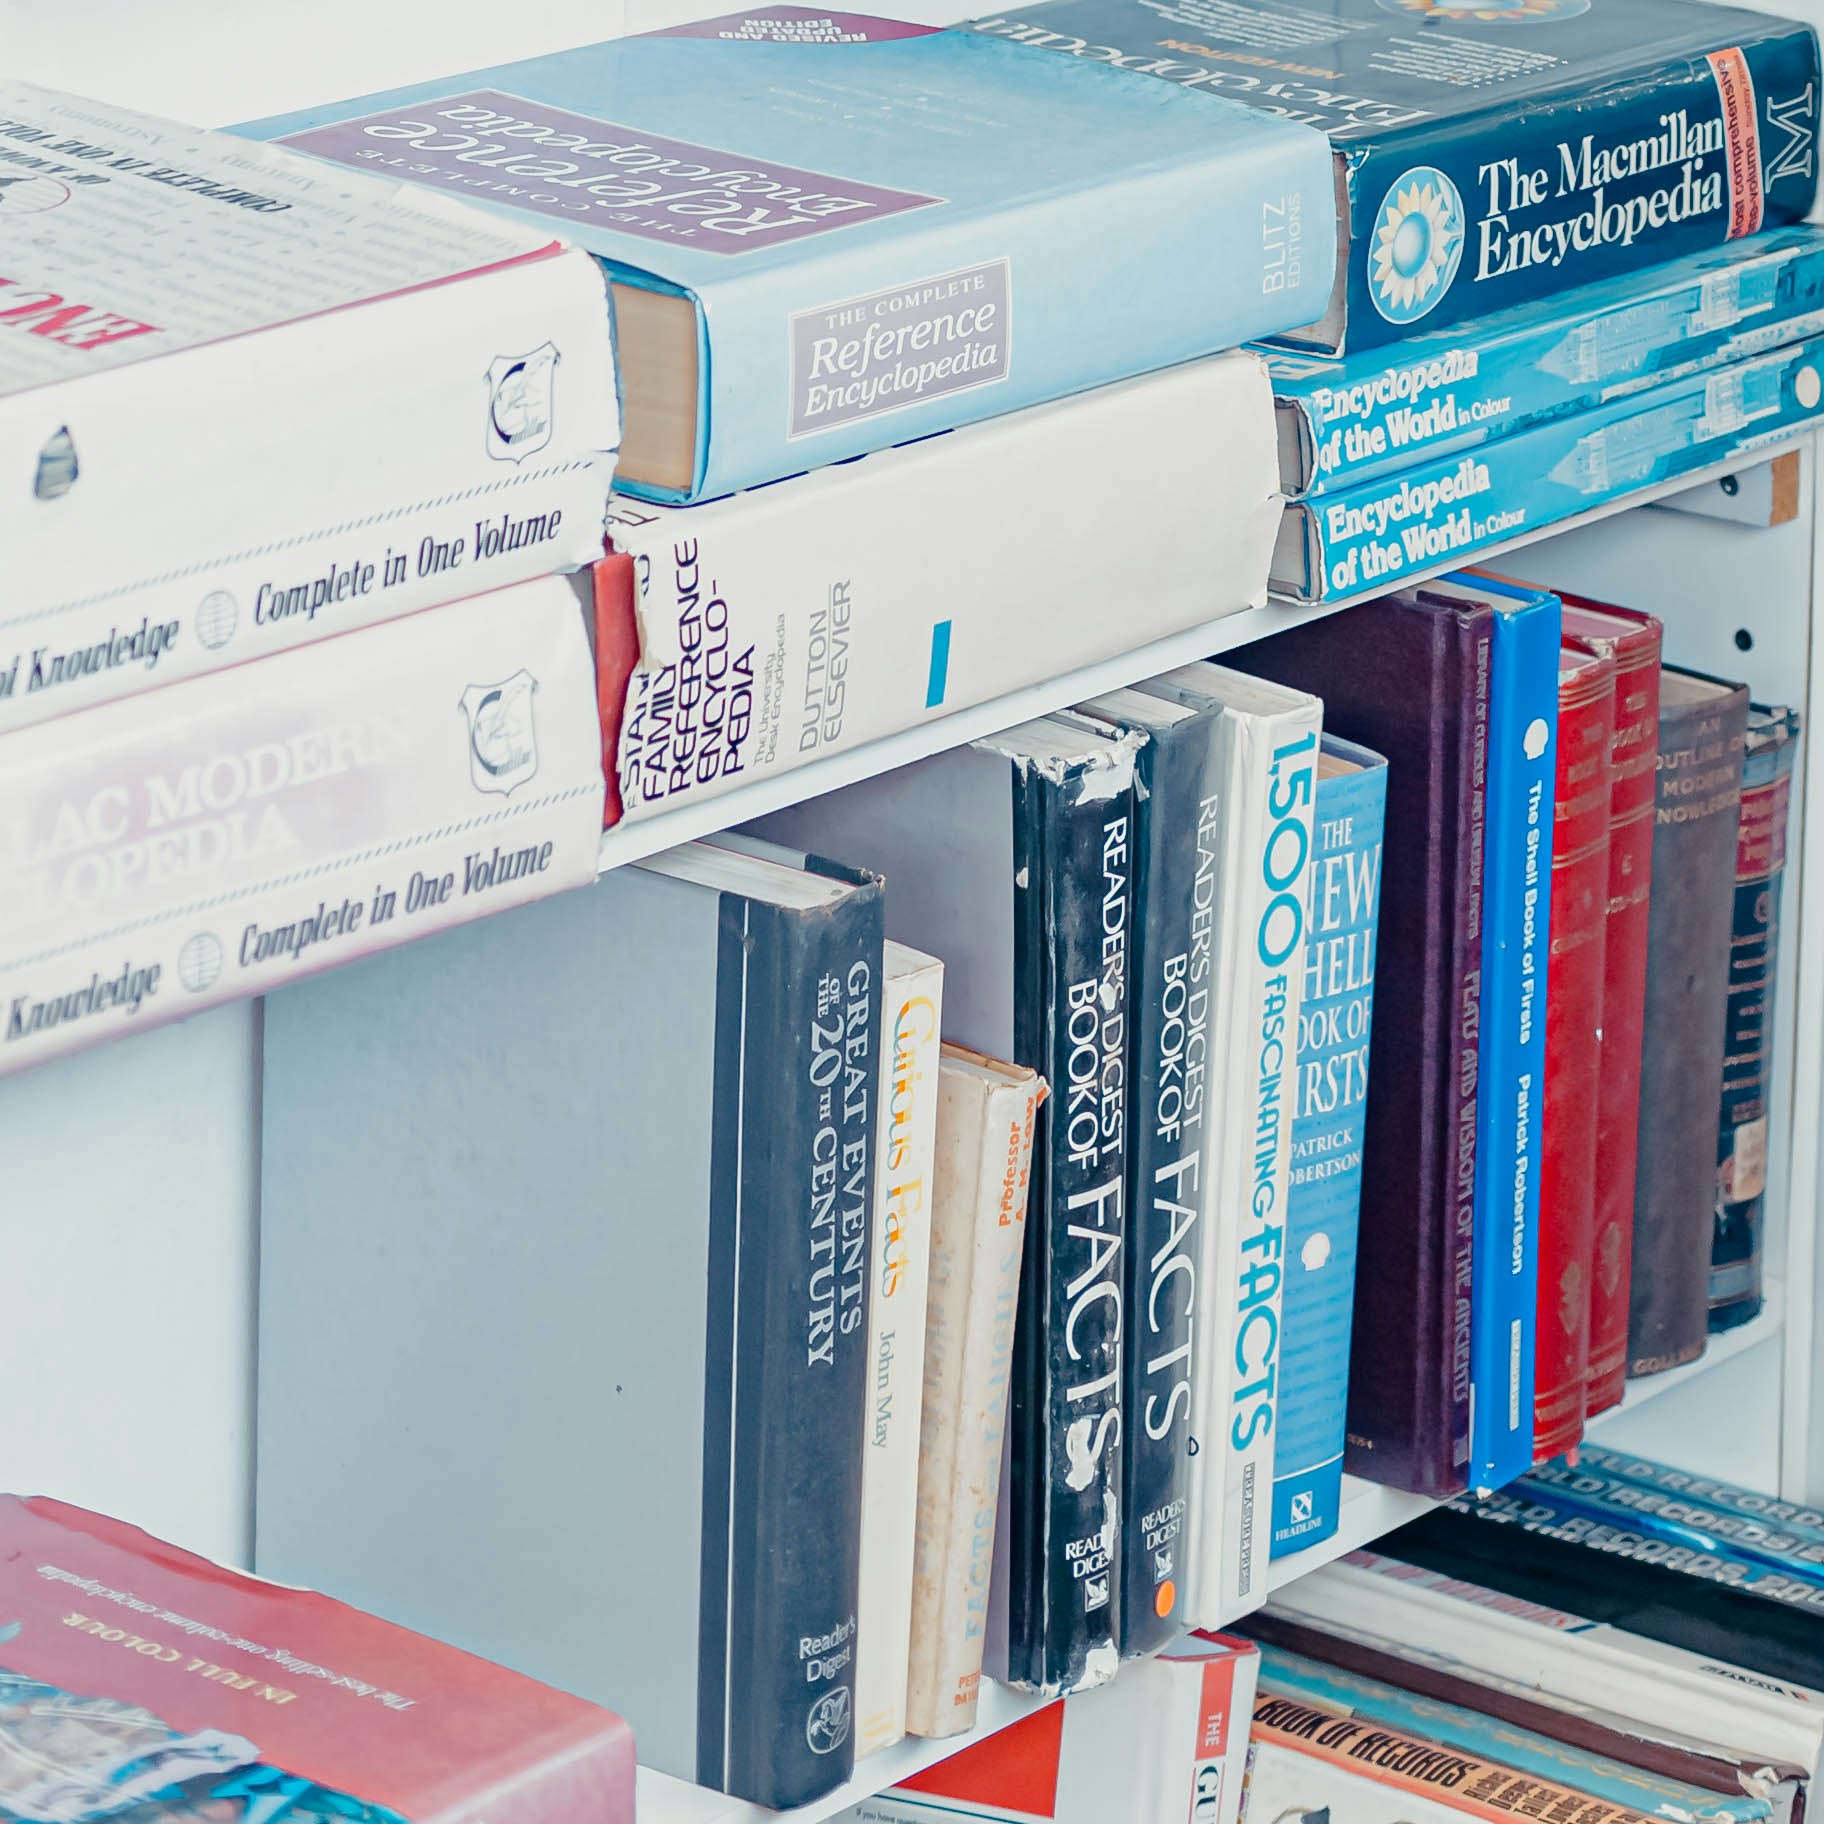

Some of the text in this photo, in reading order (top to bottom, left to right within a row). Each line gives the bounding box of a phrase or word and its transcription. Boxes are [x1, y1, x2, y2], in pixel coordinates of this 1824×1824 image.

[363, 120, 818, 238] Reference
[436, 102, 877, 217] Encyclopedia
[1477, 108, 1726, 219] The Macmillan
[1261, 195, 1288, 295] BLITZ
[1287, 191, 1302, 290] EDITIONS
[1473, 164, 1724, 282] Encyclopedia
[808, 302, 997, 380] Reference
[824, 274, 985, 329] THE COMPLETE
[803, 342, 998, 417] Encyclopedia
[1316, 348, 1480, 422] Encyclopedia
[1319, 391, 1513, 473] of the World in Colour
[1327, 460, 1491, 545] Encyclopedia
[1330, 505, 1526, 590] of the World in Colour
[27, 507, 563, 694] Knowledge Complete in One Volume
[667, 536, 699, 796] REFERENCE
[720, 643, 755, 777] PEDIA
[798, 609, 828, 752] DUTTON
[823, 578, 851, 743] ELSEVIER
[1321, 816, 1353, 852] THE
[238, 839, 554, 968] Complete in One Volume
[818, 972, 830, 1019] THE
[1183, 793, 1219, 1130] READER'S DIGEST
[1511, 779, 1543, 1276] The Shell Book of Firsts Patrick Robertson
[1100, 1012, 1125, 1156] DIGEST
[1231, 731, 1317, 1453] 1,500 FASCINATING FACTS
[839, 959, 870, 1335] GREAT EVENTS
[998, 1121, 1021, 1227] Professor
[1145, 953, 1200, 1442] BOOK OF FACTS
[807, 1126, 839, 1369] CENTURY
[881, 1175, 925, 1300] Facts
[1064, 978, 1123, 1494] BOOK OF FACTS
[876, 1329, 896, 1392] John
[871, 1397, 896, 1449] May
[1275, 1514, 1323, 1542] HEADLINE
[799, 1615, 857, 1659] Reader's
[805, 1646, 852, 1682] Digest
[1204, 1711, 1223, 1748] THE
